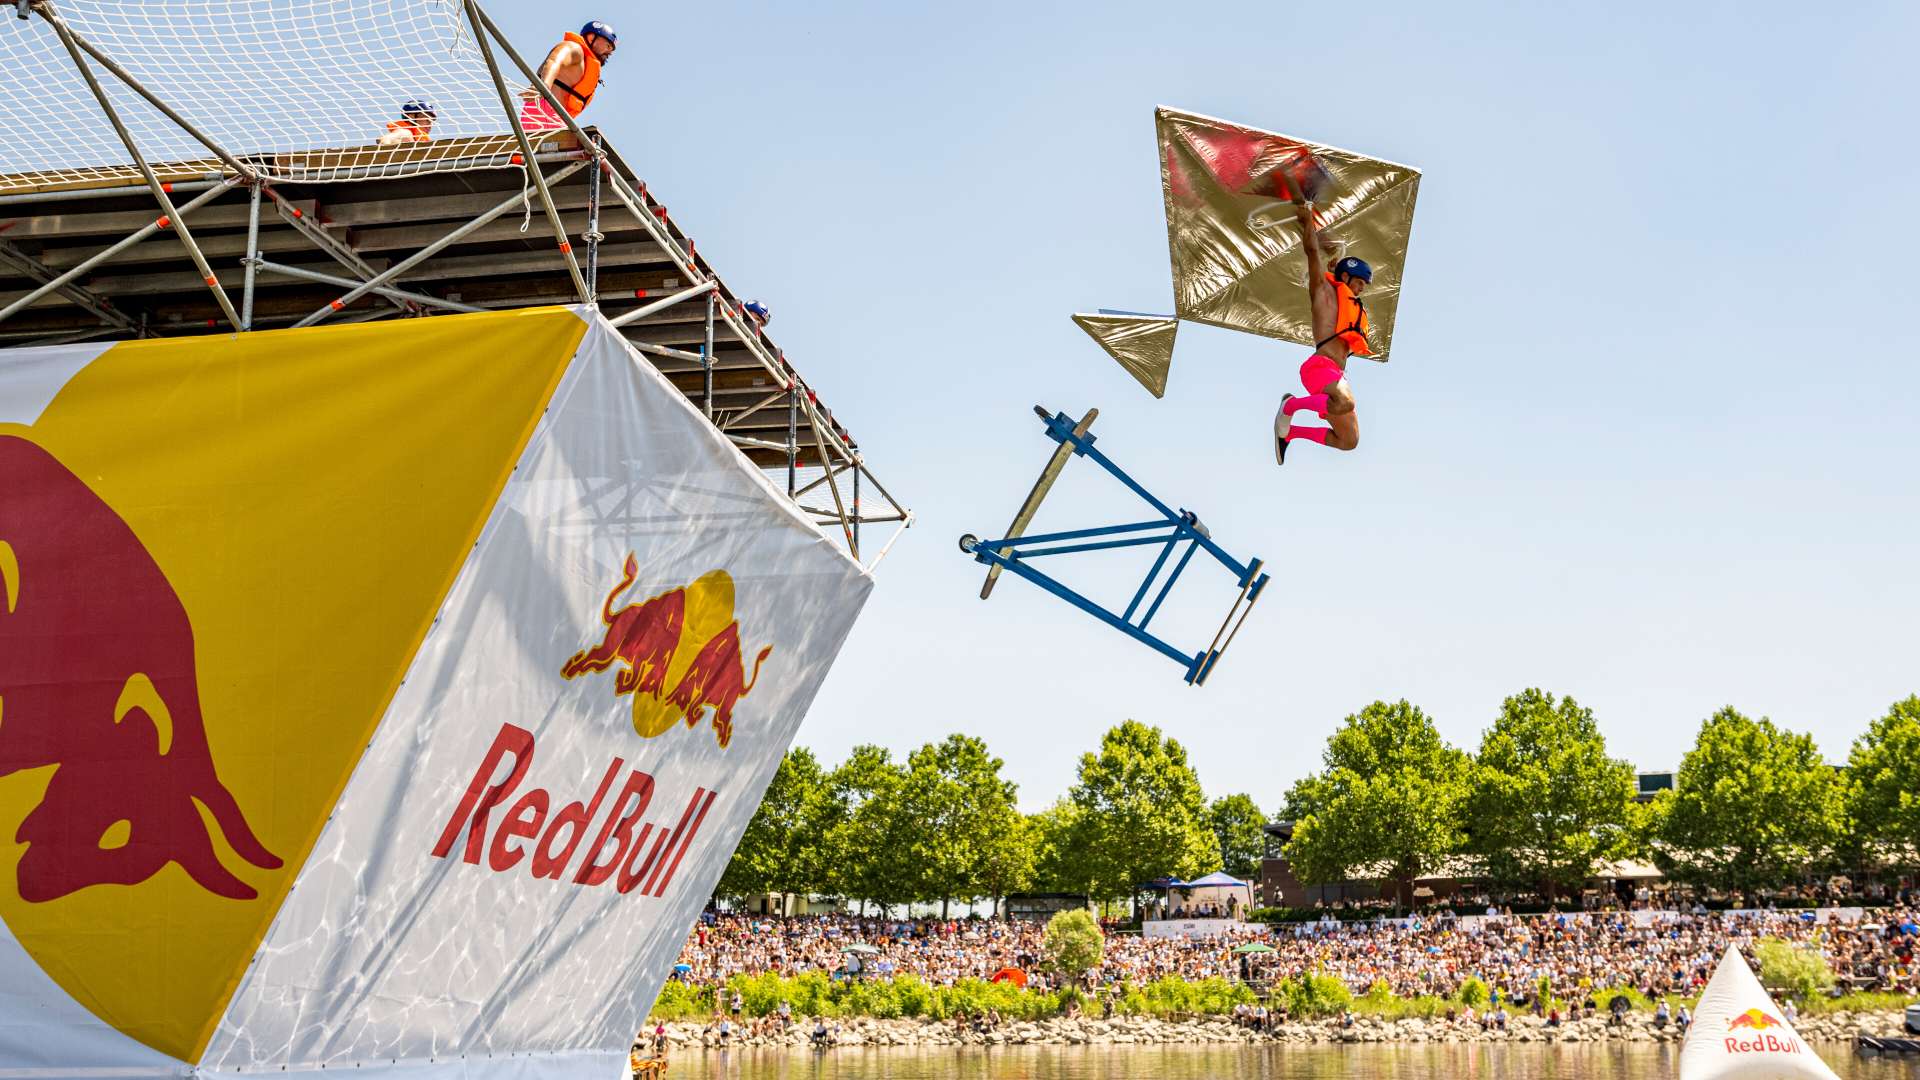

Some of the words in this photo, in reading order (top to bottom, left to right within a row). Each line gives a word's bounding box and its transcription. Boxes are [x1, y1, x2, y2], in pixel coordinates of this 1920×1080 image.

[432, 722, 625, 880] Red
[572, 769, 717, 898] Bull
[1725, 1034, 1765, 1053] Red
[1766, 1035, 1801, 1054] Bull
